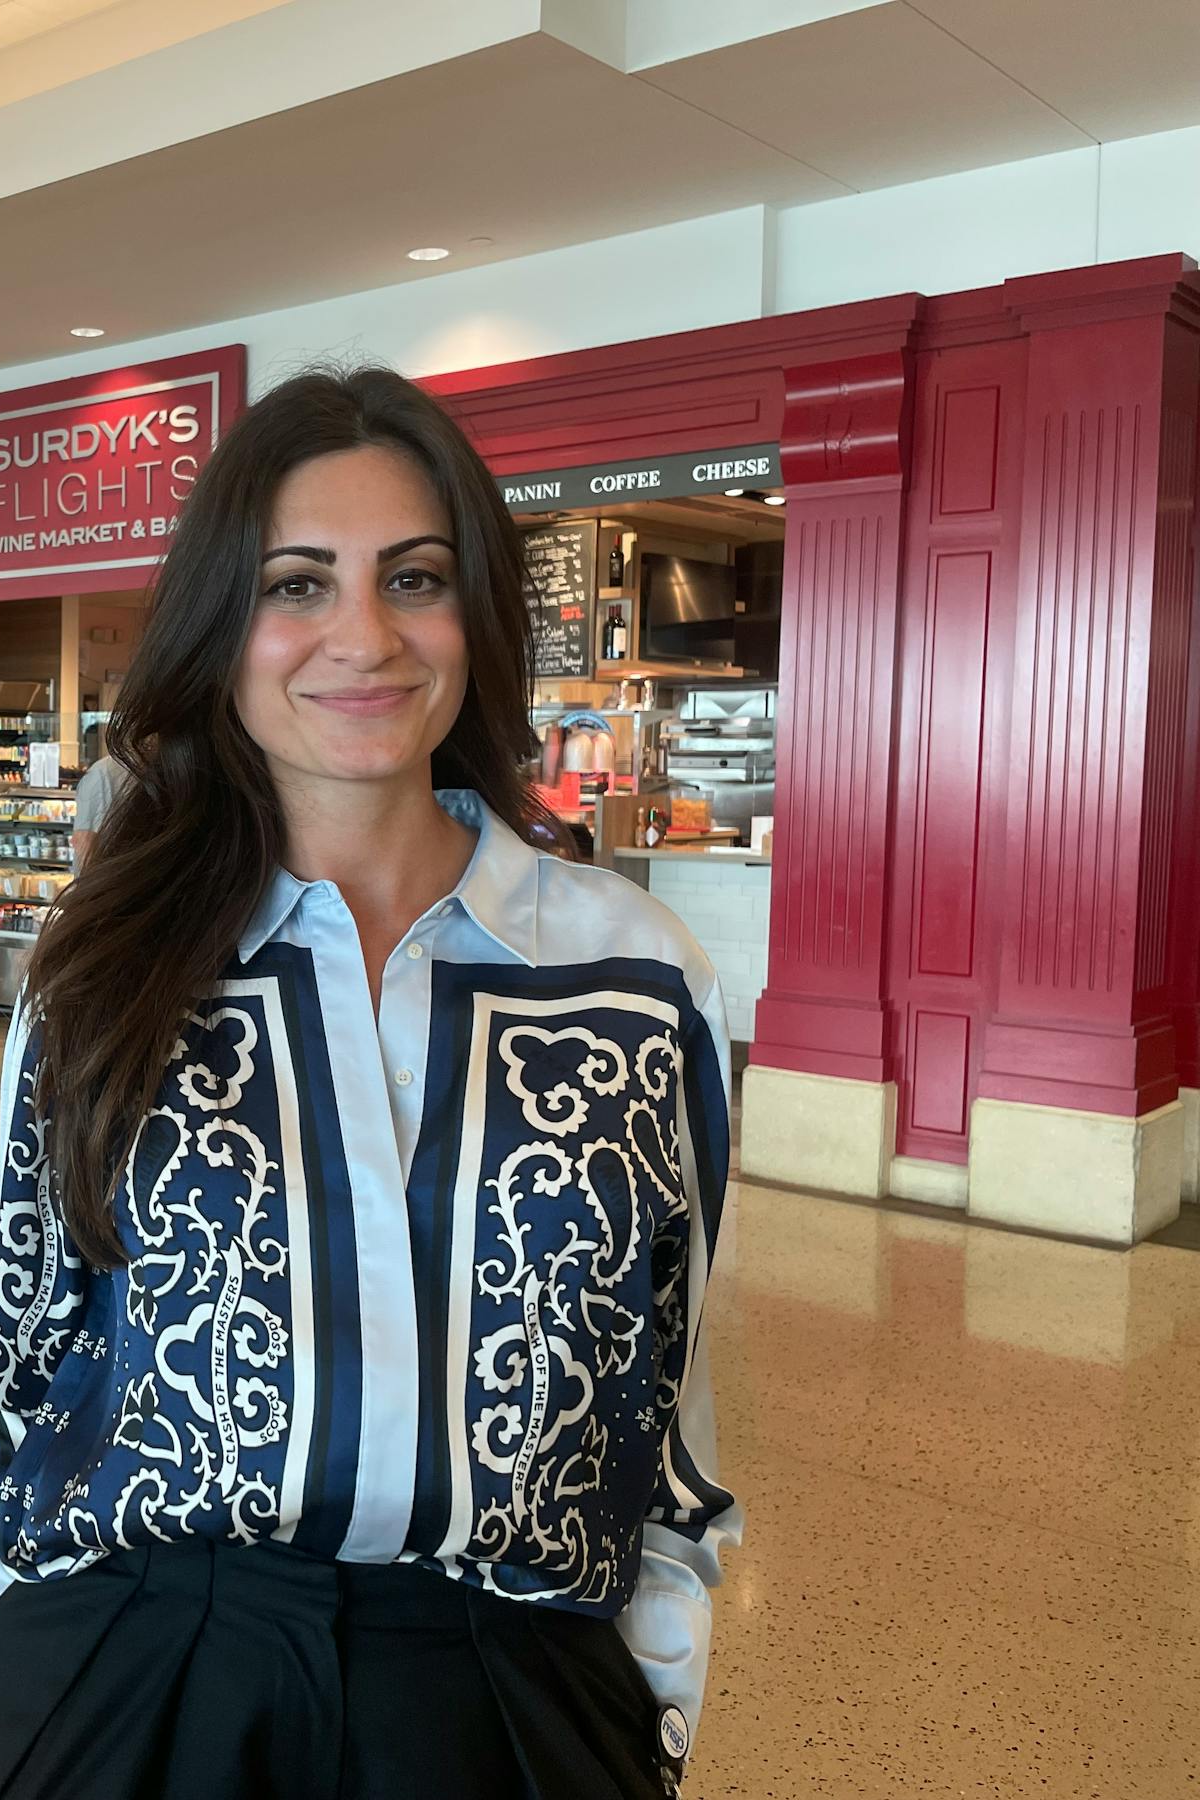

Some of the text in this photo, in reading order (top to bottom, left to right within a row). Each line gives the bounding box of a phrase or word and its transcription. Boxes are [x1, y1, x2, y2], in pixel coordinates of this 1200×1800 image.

[40, 521, 128, 550] MARKET
[131, 519, 146, 539] &
[504, 457, 770, 504] PANINI COFFEE CHEESE
[20, 1185, 55, 1338] CLASH OF THE MASTERS
[214, 1275, 240, 1465] CLASH OF THE MASTERS
[260, 1312, 281, 1443] SCOTCH & SODA
[514, 1302, 548, 1492] CLASH OF THE MASTERS
[662, 1719, 685, 1750] msp
